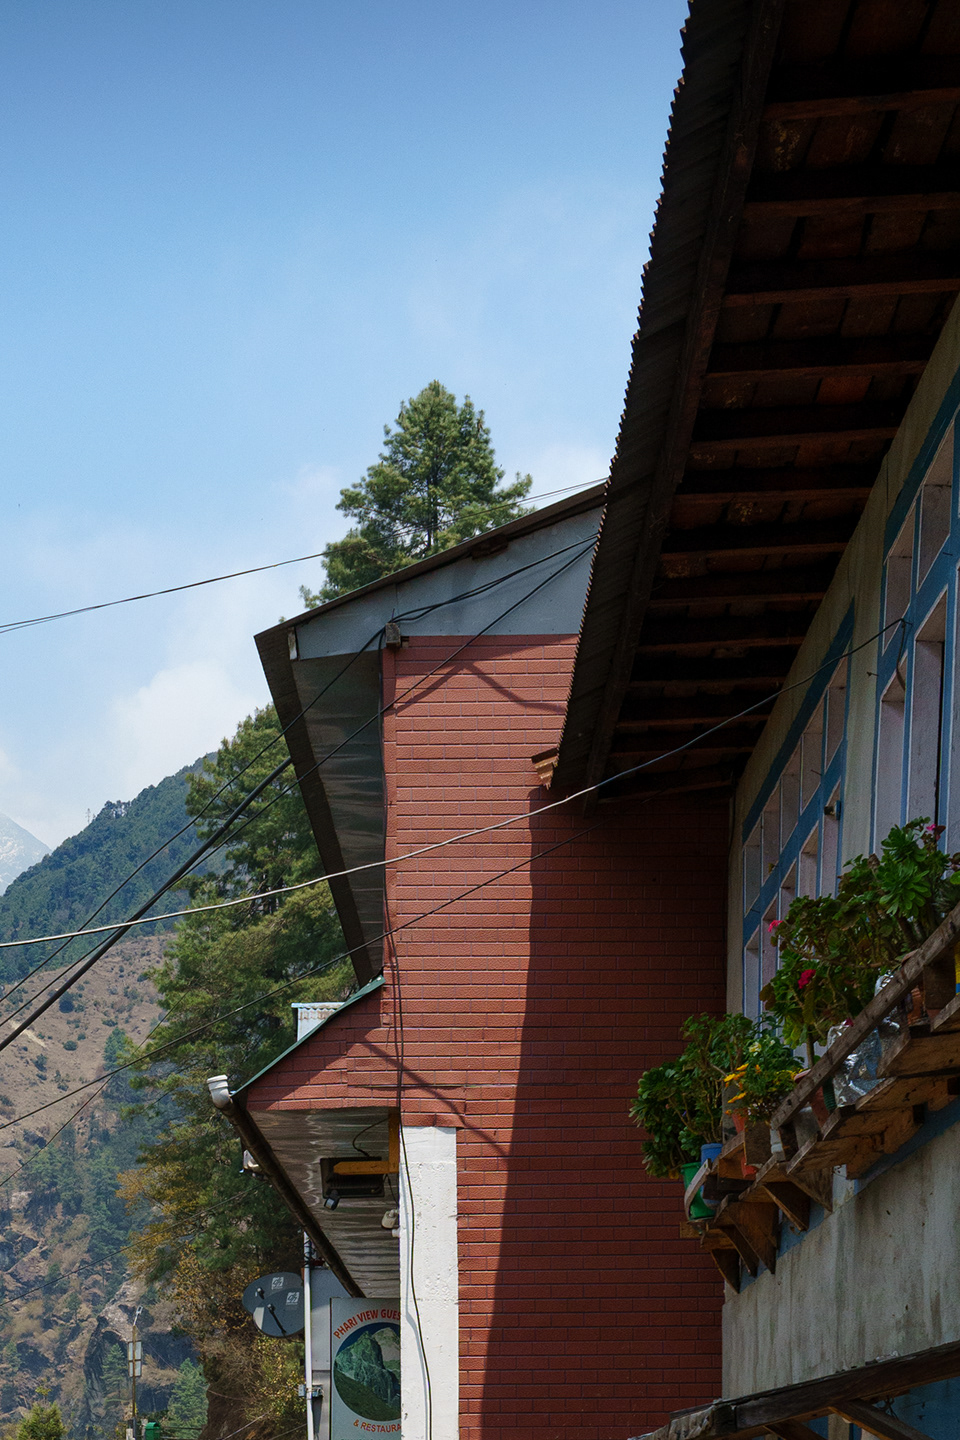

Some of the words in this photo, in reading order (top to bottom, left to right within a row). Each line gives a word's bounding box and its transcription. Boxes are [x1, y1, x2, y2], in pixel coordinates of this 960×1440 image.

[333, 1316, 358, 1339] PHARI
[356, 1309, 379, 1323] VIEW
[353, 1419, 360, 1427] &
